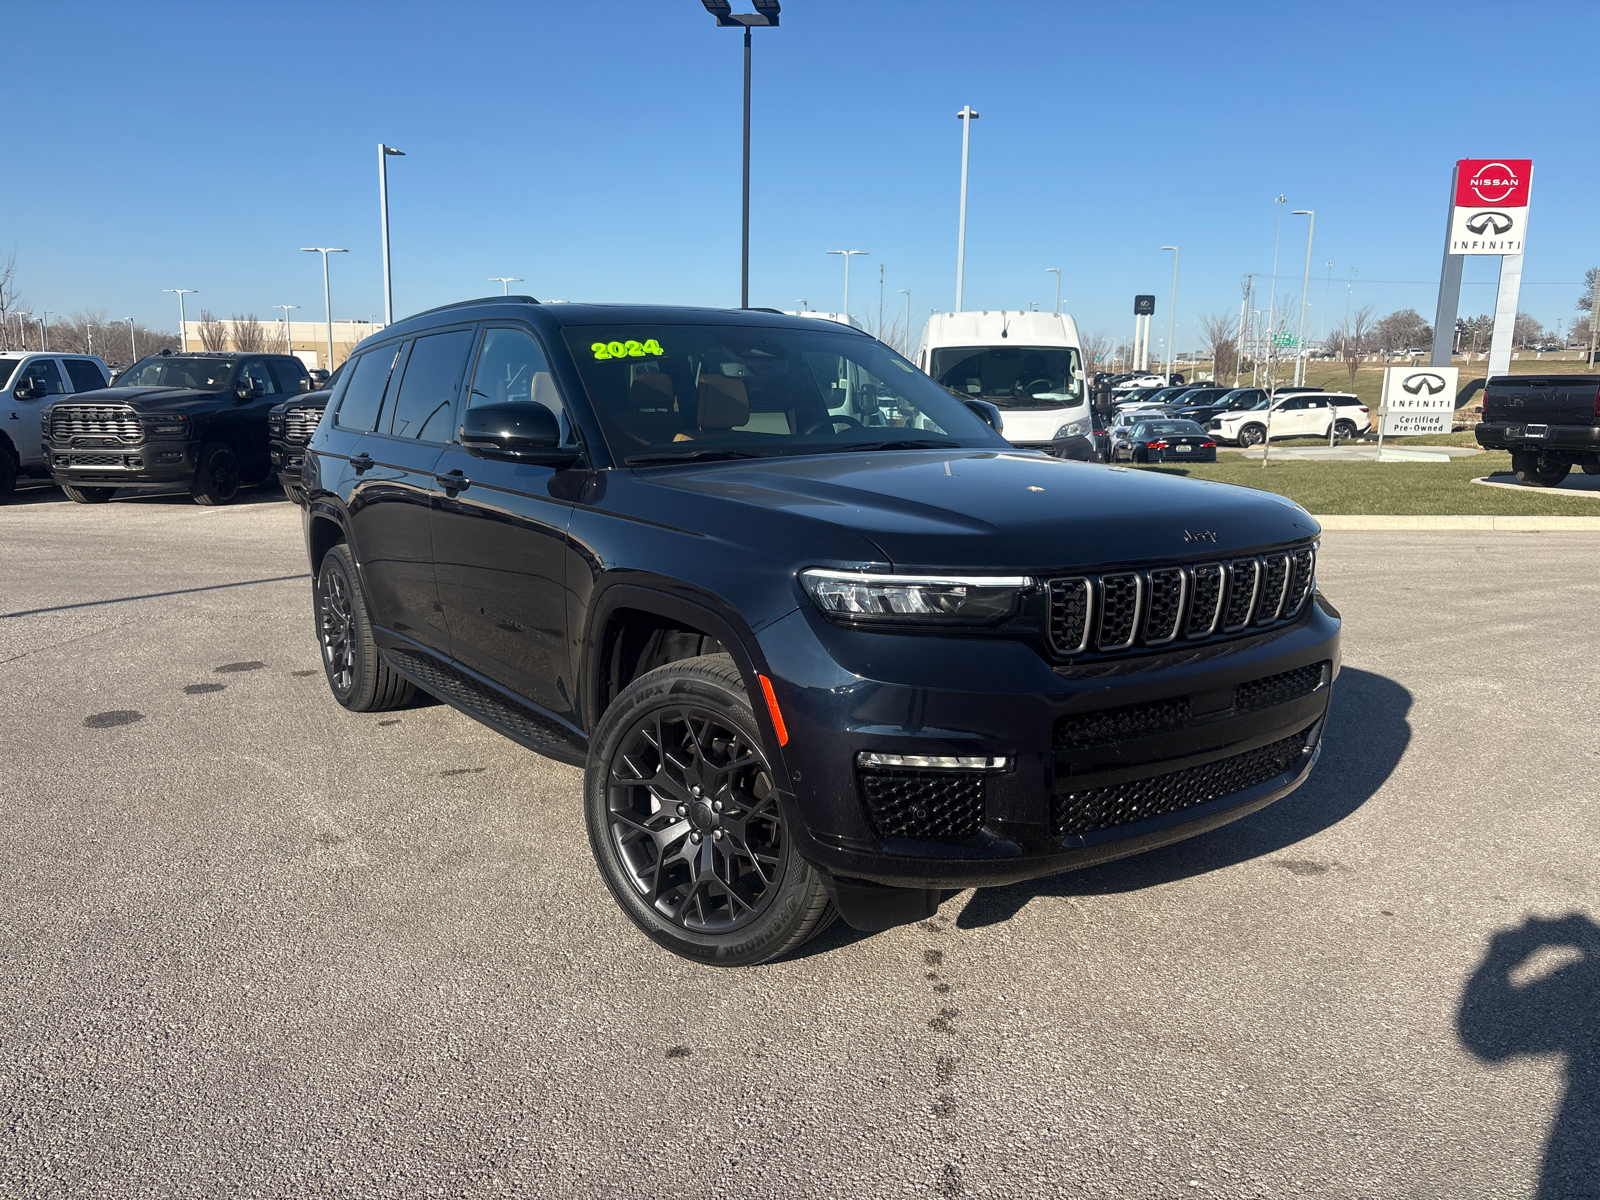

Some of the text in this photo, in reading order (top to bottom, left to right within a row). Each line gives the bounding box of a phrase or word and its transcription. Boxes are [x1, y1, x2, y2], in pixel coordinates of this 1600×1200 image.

[1453, 241, 1521, 250] INFINITI
[591, 339, 664, 360] 2024
[1392, 400, 1451, 408] INFINITI
[69, 412, 114, 420] RAM
[1399, 416, 1440, 424] Certified
[1393, 424, 1444, 432] Pre-Owned
